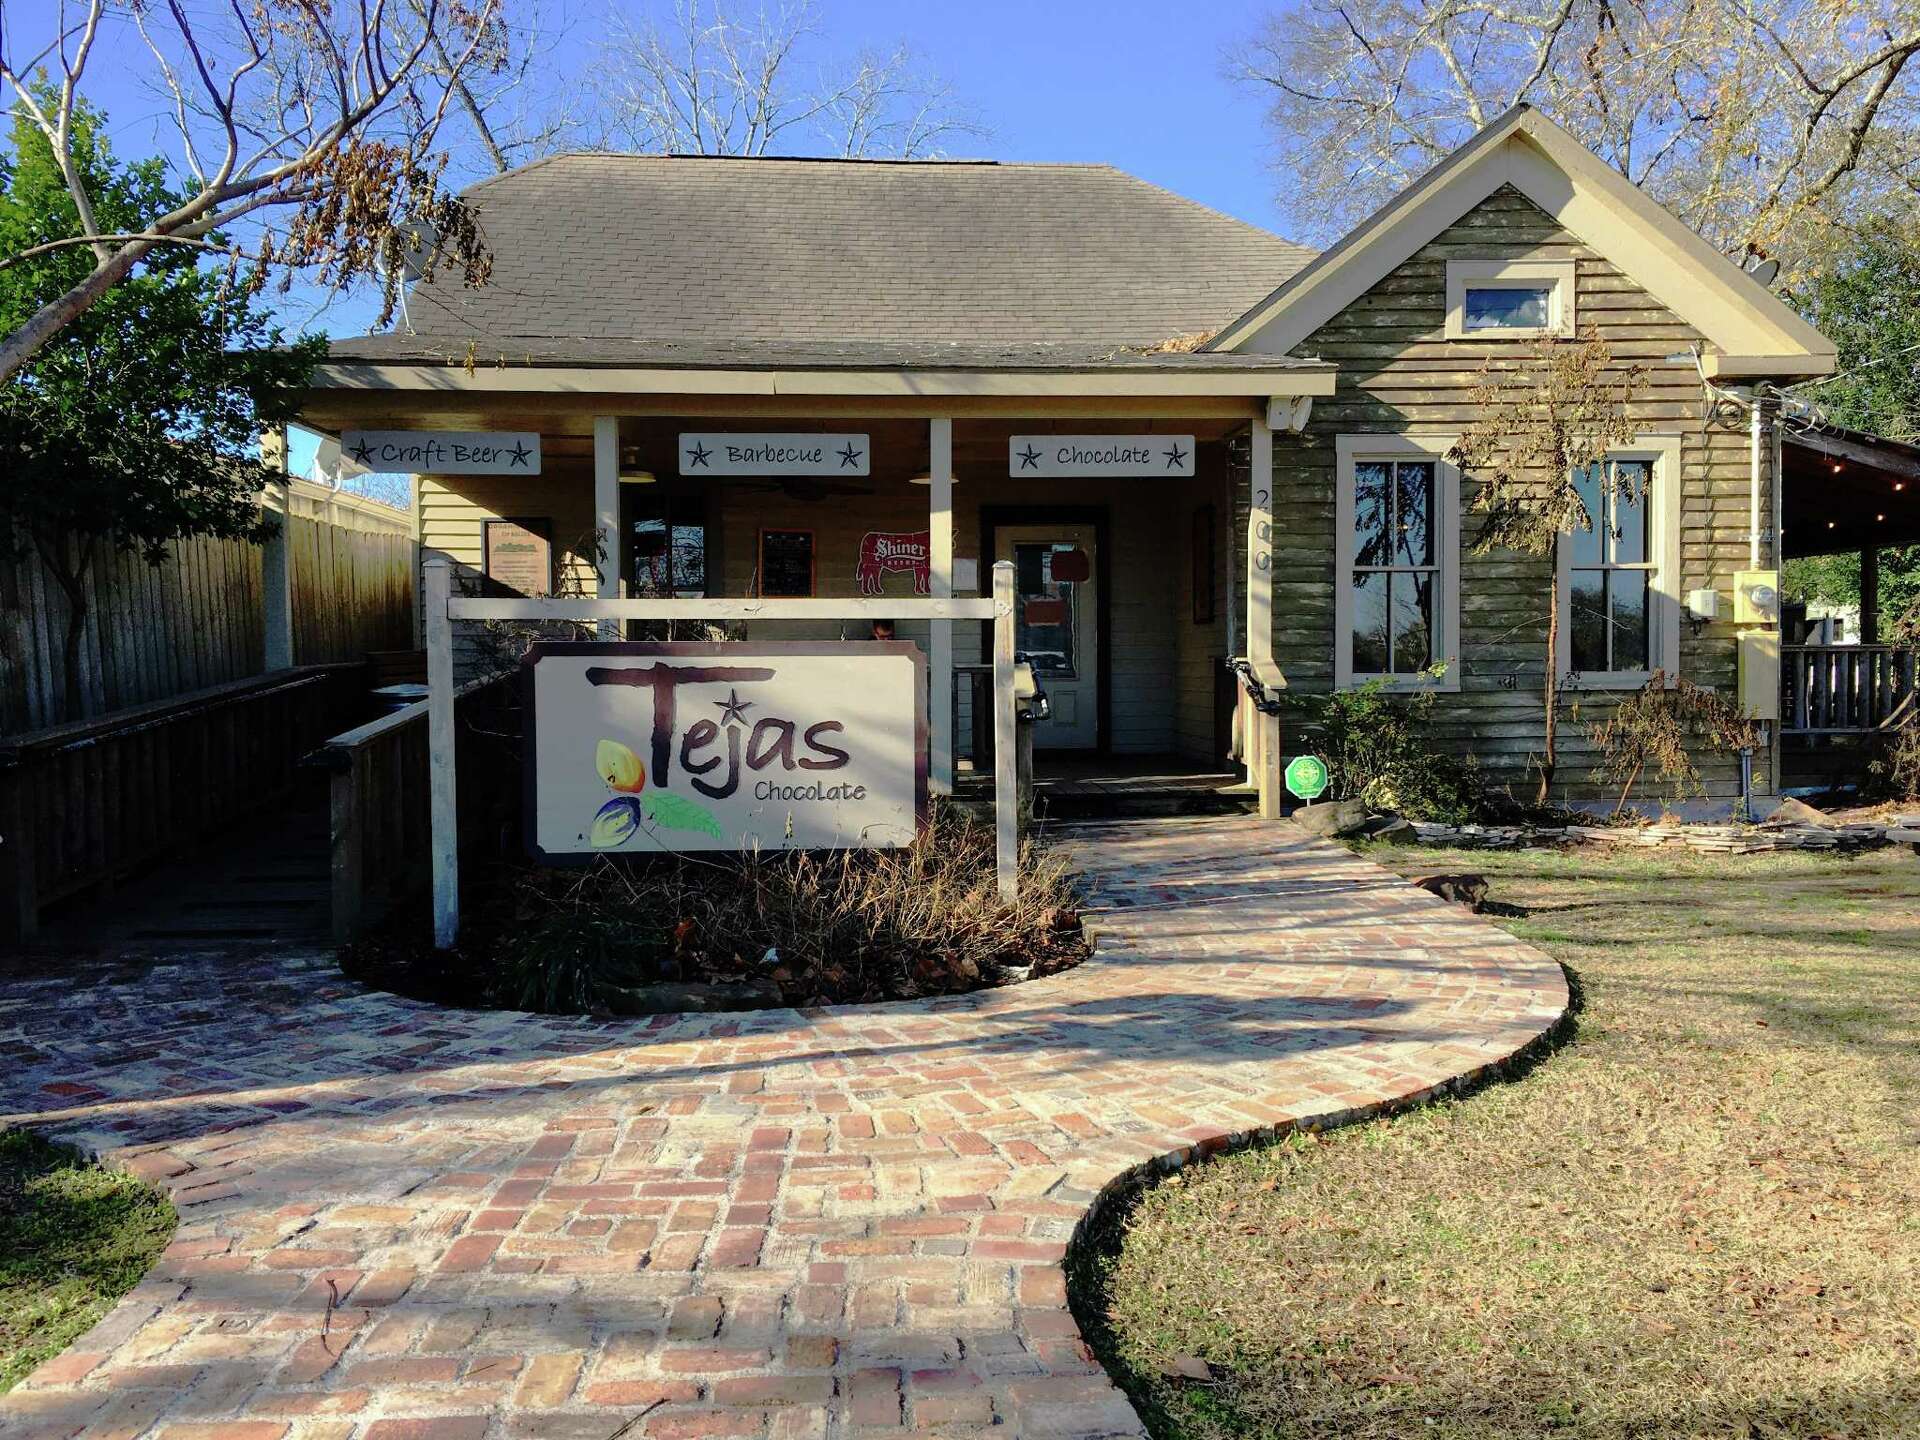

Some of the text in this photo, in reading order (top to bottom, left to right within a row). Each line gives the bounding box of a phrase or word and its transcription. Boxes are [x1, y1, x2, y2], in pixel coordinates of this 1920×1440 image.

[381, 439, 504, 469] Craft Beer
[725, 442, 825, 464] Barbecue
[1056, 445, 1152, 465] Chocolate
[874, 537, 926, 562] Shiner
[585, 661, 851, 801] Tejas
[754, 780, 867, 802] Chocolate
